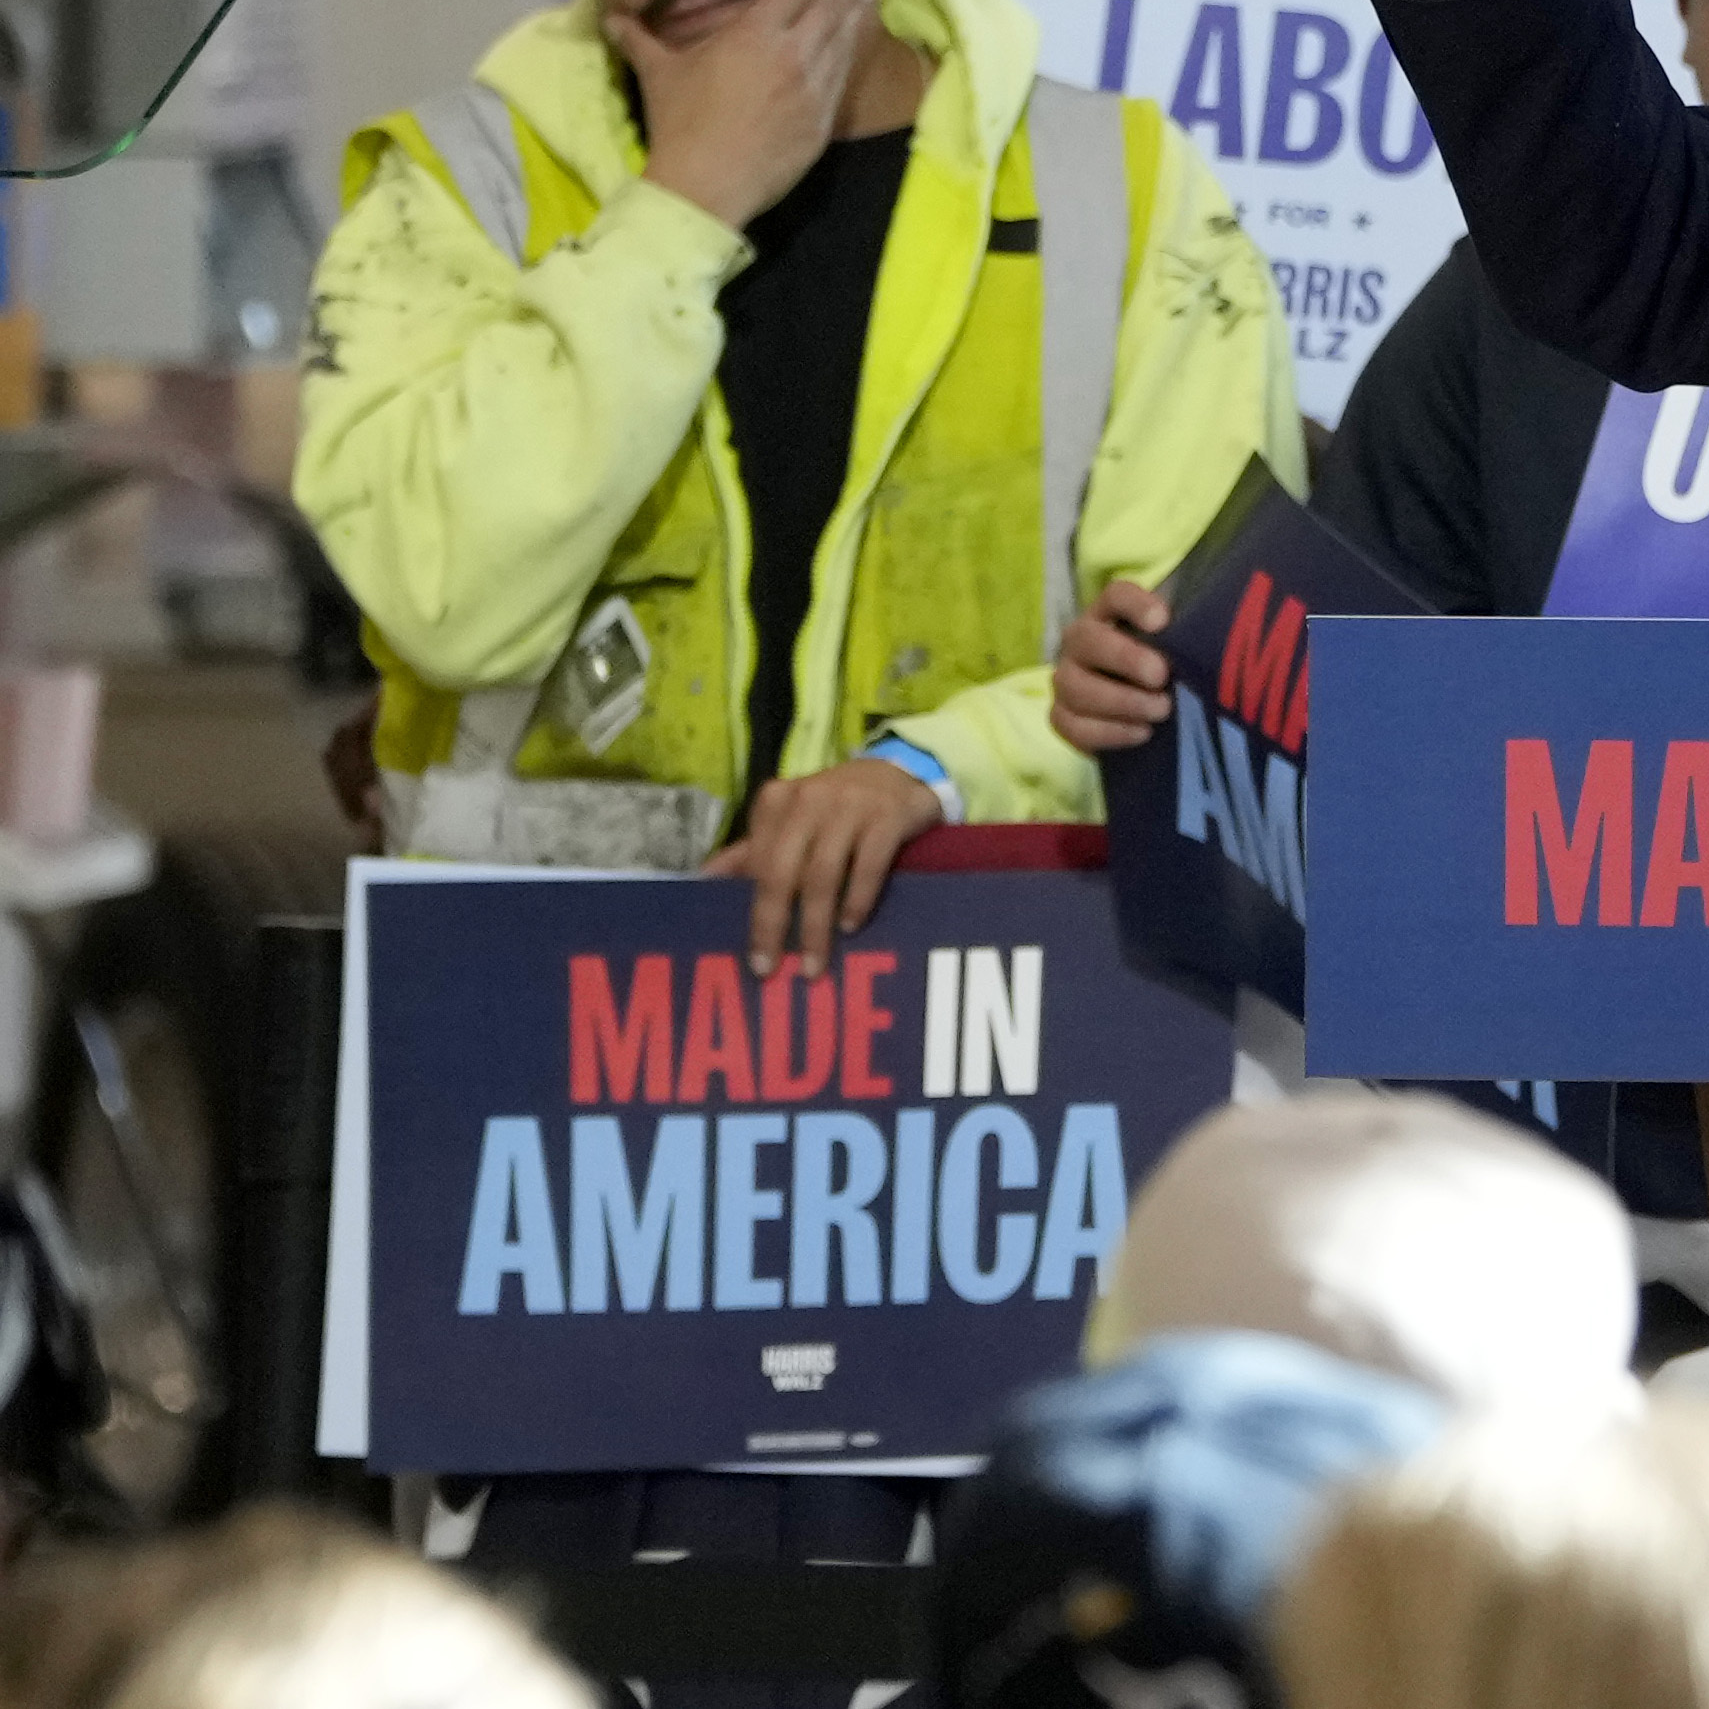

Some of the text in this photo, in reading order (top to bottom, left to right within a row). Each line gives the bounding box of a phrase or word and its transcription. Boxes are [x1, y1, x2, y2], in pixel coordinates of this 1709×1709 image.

[1269, 203, 1329, 228] FOR
[569, 946, 1043, 1104] MADE IN
[458, 1103, 1129, 1314] AMERICA
